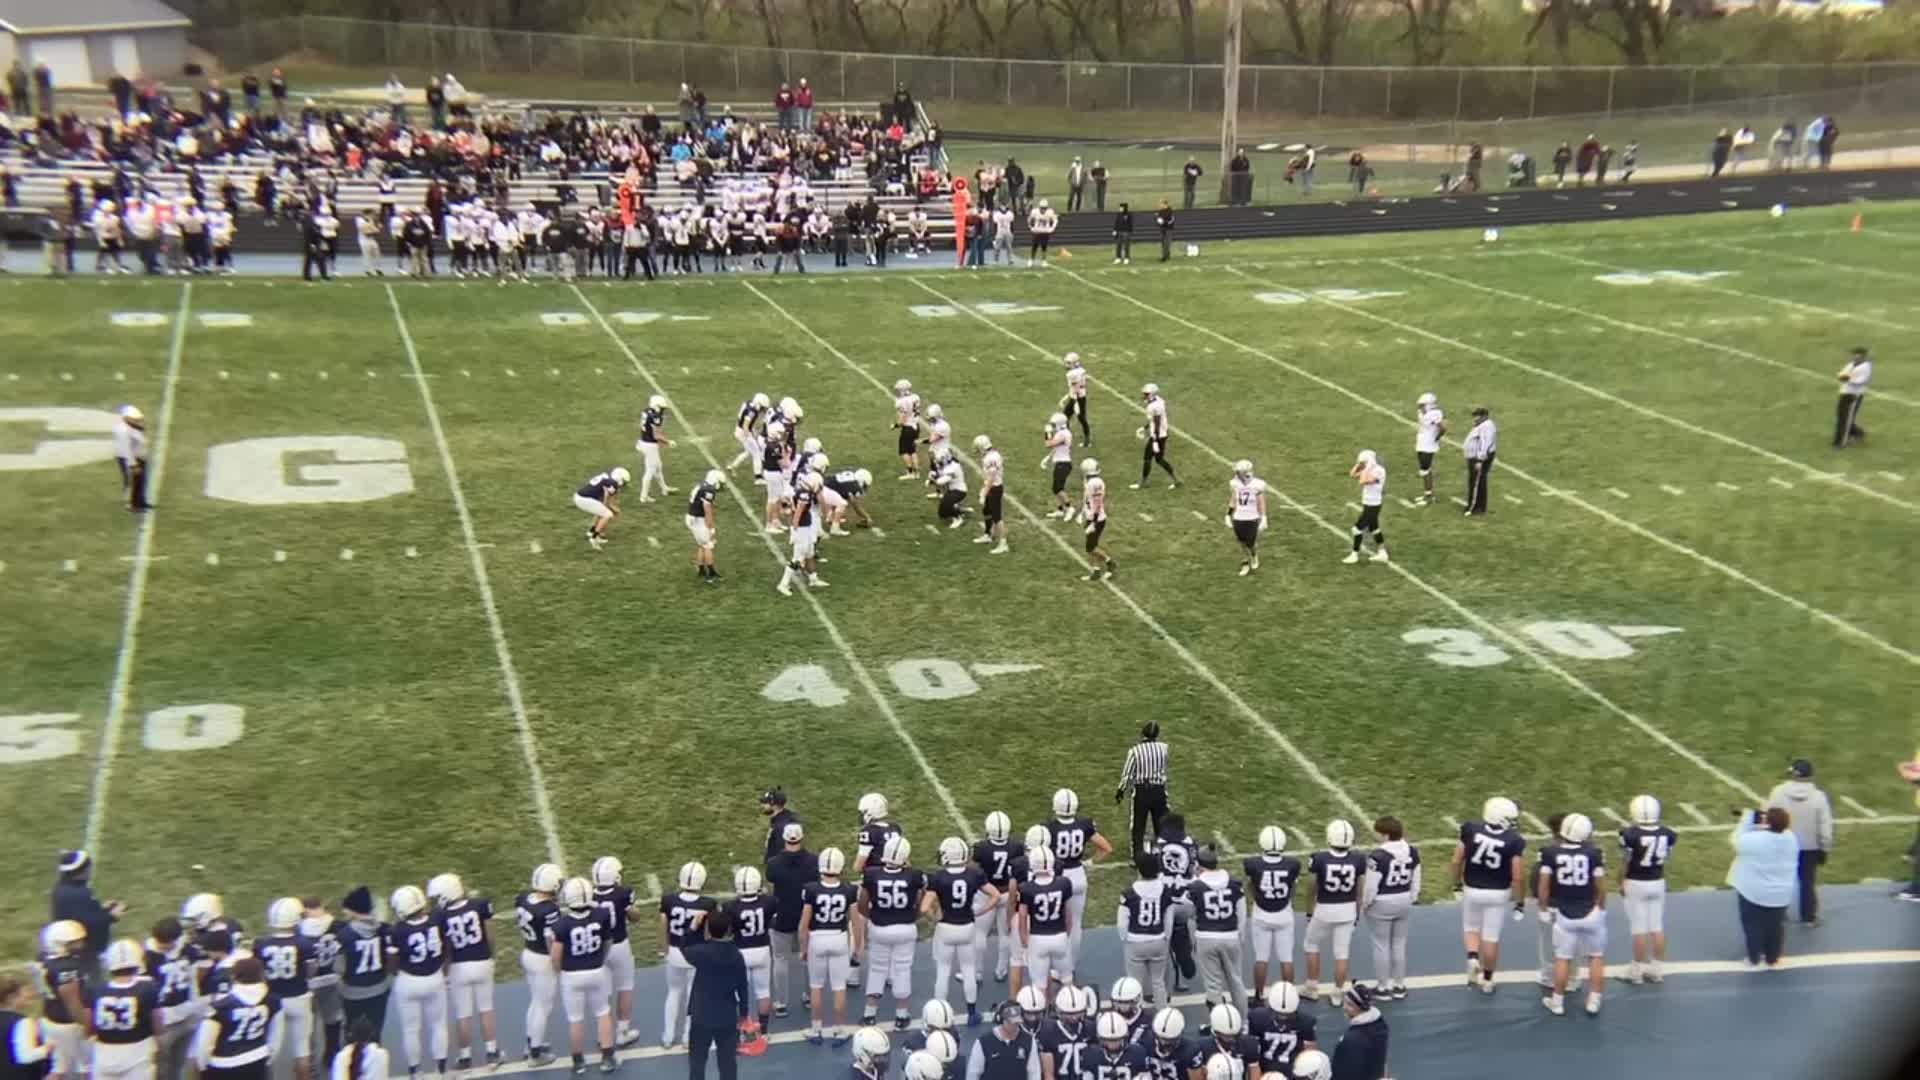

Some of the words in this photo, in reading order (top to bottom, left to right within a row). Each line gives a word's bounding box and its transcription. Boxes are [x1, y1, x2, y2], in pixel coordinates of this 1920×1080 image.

[1056, 829, 1084, 858] 88
[1471, 834, 1505, 869] 75
[992, 851, 1009, 880] 7
[1324, 863, 1356, 893] 53
[1556, 855, 1589, 885] 28
[876, 879, 908, 908] 56
[951, 879, 968, 908] 9
[1259, 870, 1289, 899] 45
[815, 894, 847, 923] 32
[1034, 891, 1063, 921] 37
[1138, 897, 1161, 926] 81
[1204, 888, 1234, 920] 55
[446, 910, 482, 949] 83
[739, 907, 765, 937] 31
[407, 926, 442, 964] 34
[570, 923, 601, 956] 86
[262, 945, 298, 979] 38
[355, 936, 383, 974] 71
[227, 1005, 270, 1042] 72
[1264, 1031, 1297, 1063] 77
